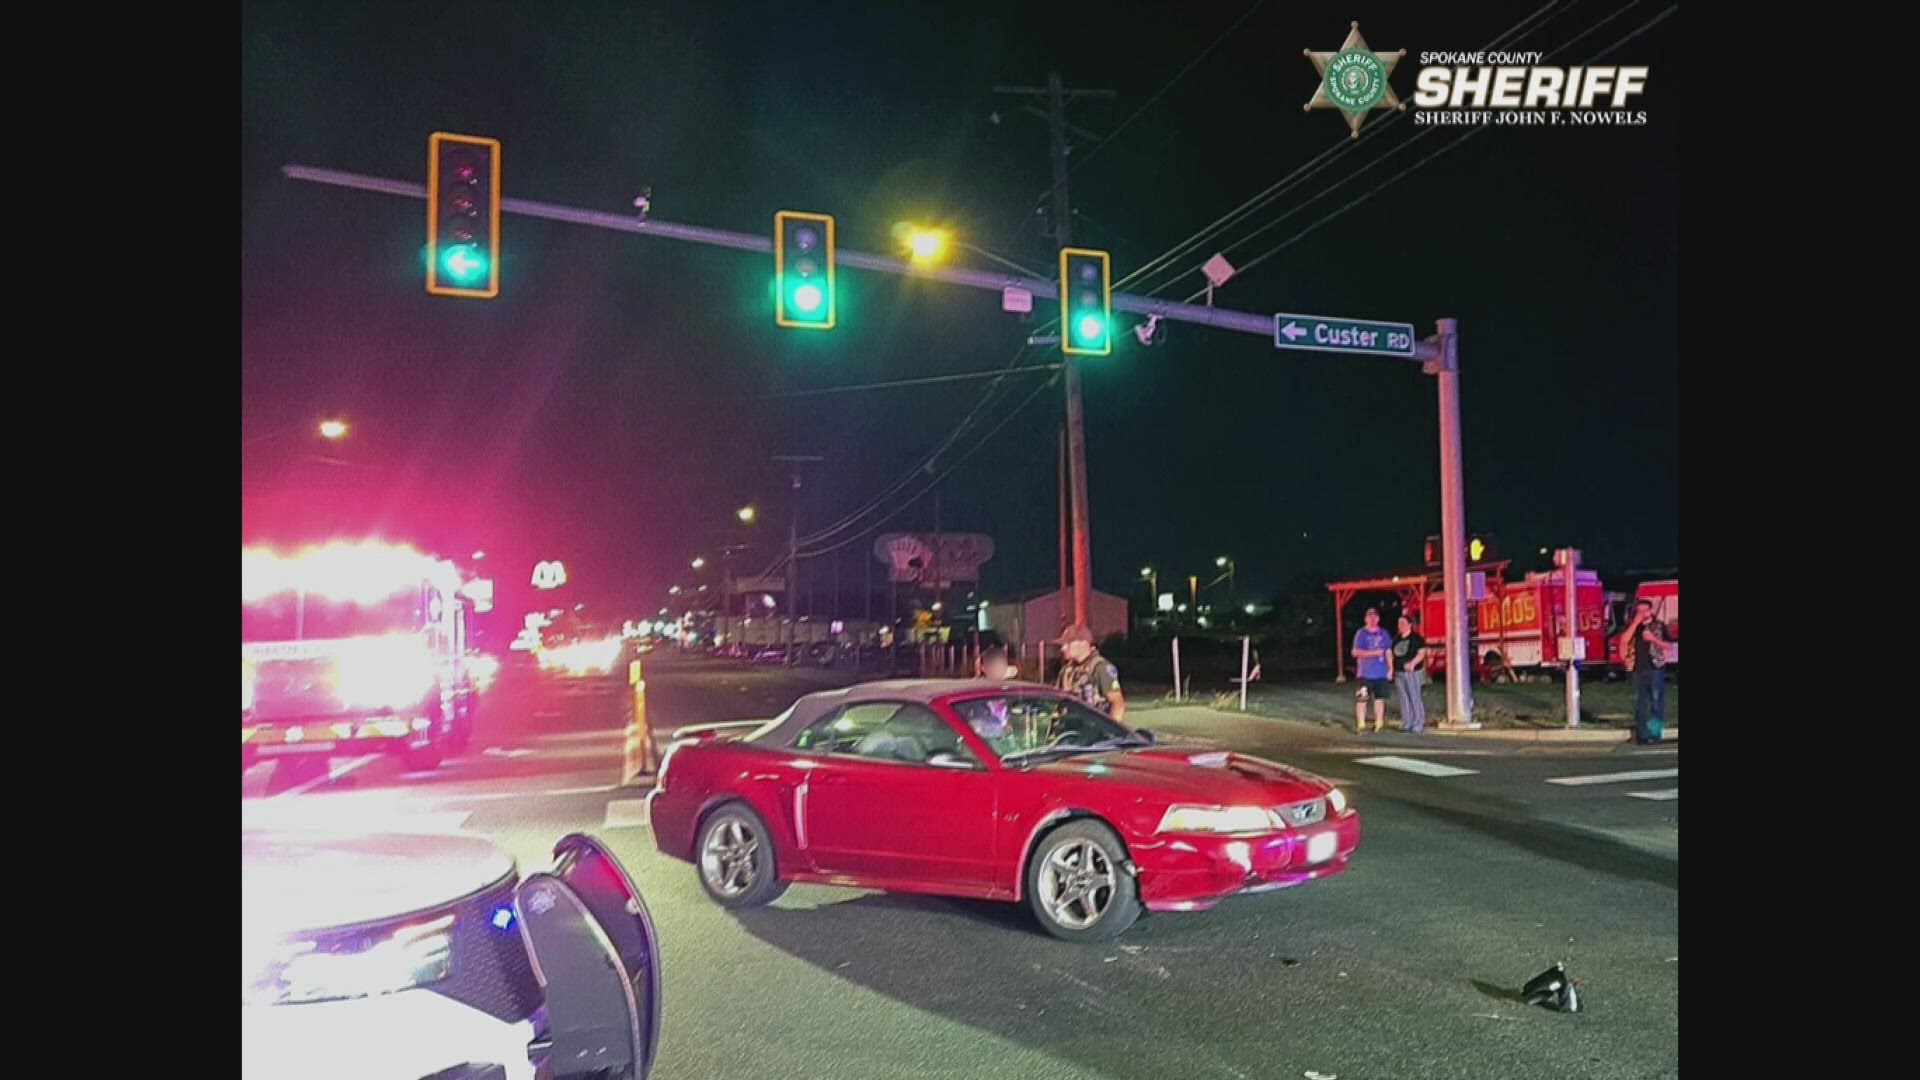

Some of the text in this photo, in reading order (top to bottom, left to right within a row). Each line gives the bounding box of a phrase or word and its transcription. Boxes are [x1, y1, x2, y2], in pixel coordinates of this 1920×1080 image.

[1314, 323, 1410, 349] Custer RD
[1483, 593, 1536, 630] TACOS
